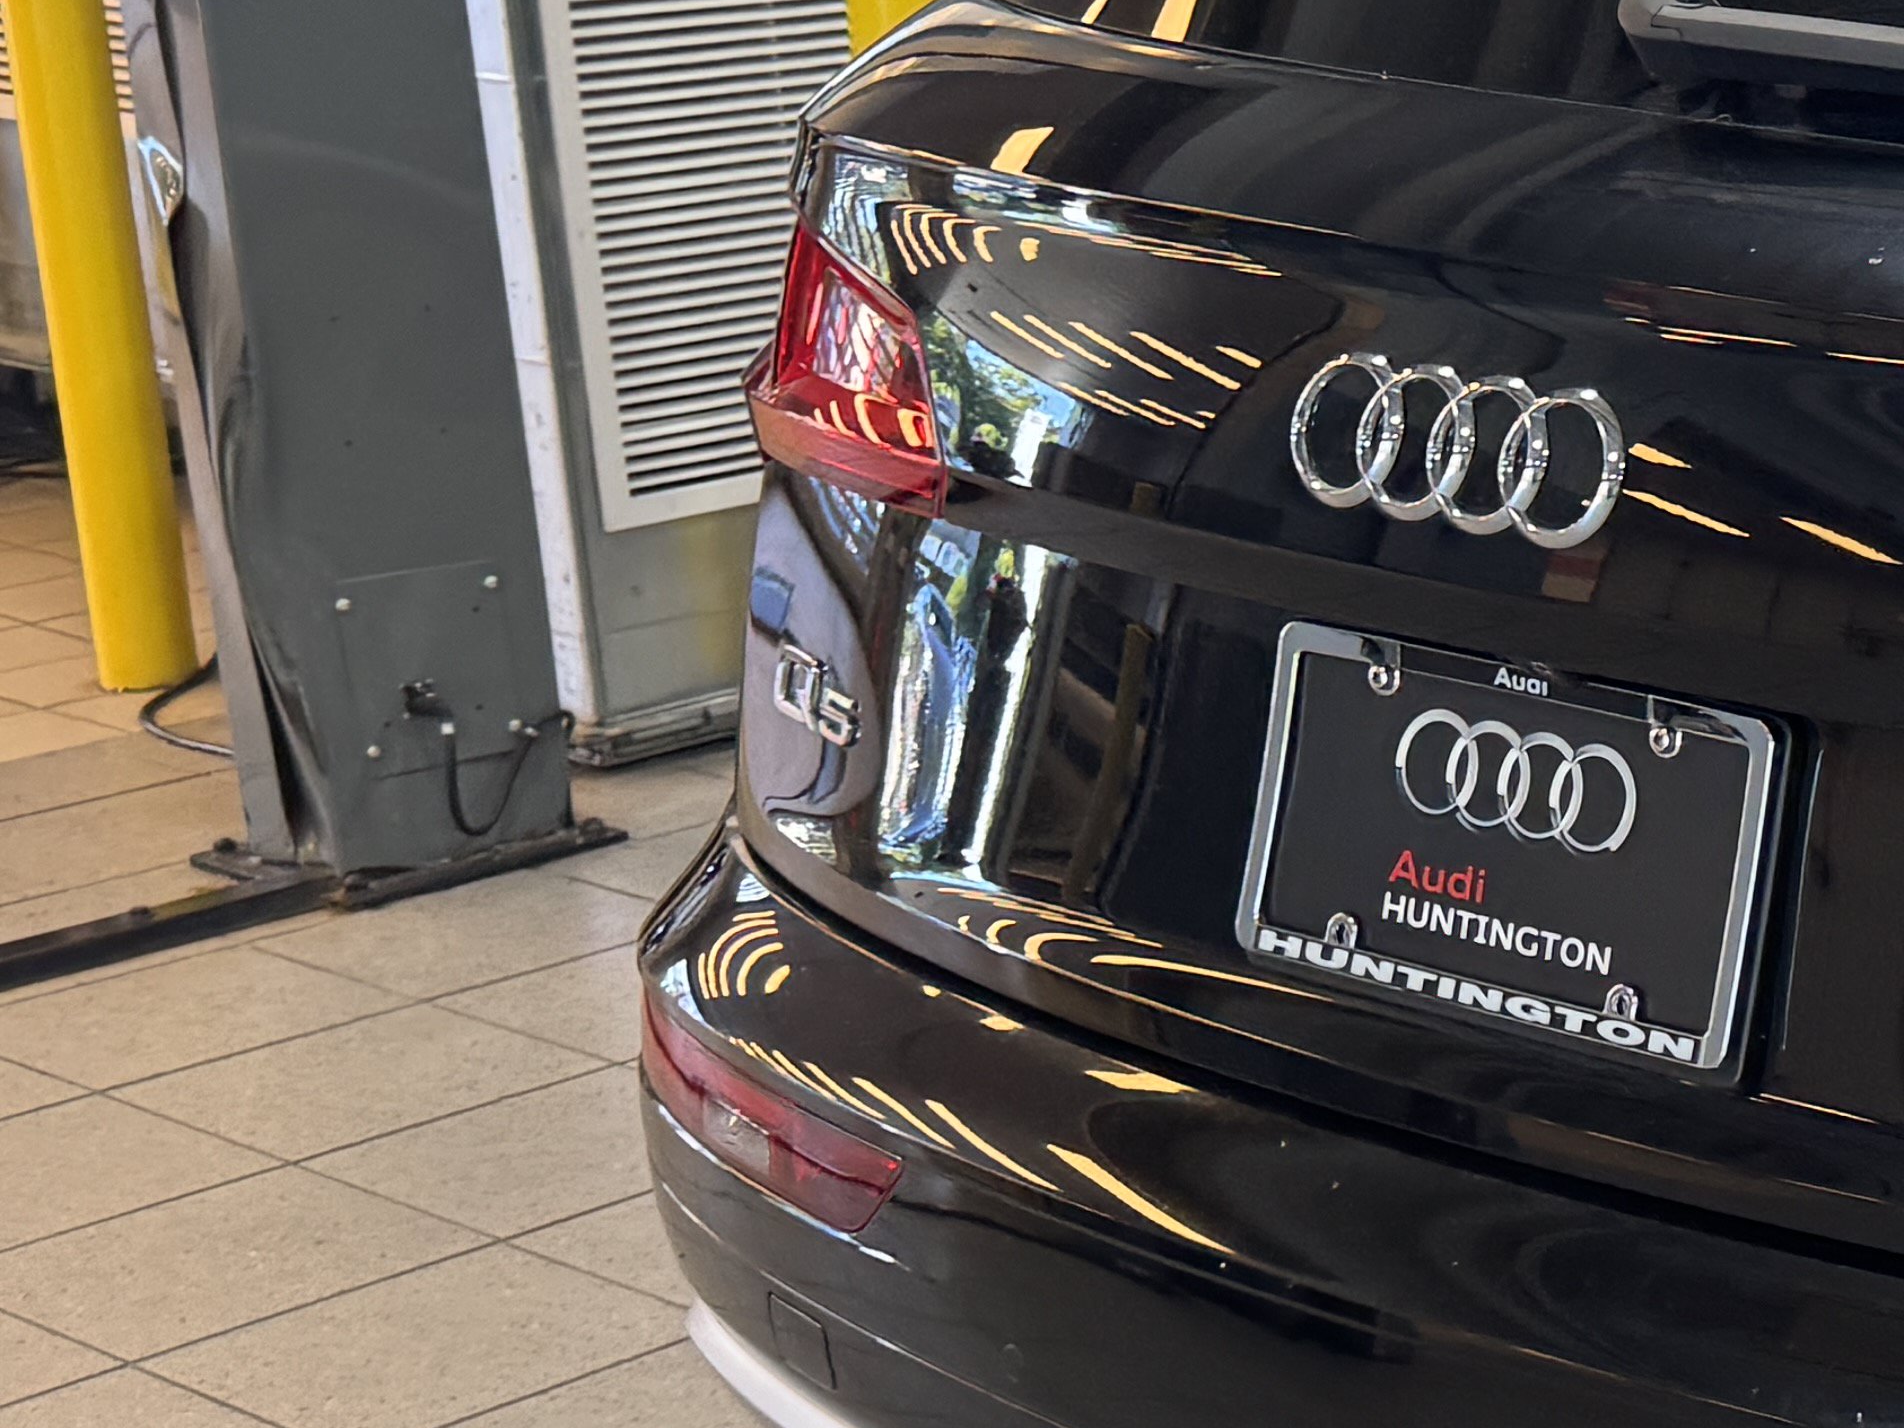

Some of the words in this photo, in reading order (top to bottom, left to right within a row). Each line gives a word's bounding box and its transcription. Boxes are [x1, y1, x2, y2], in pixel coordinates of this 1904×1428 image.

[774, 643, 861, 747] Q5
[1493, 667, 1548, 697] Audi
[1388, 849, 1487, 904] Audi
[1381, 890, 1613, 976] HUNTINGTON
[1257, 929, 1696, 1061] HUNTINGTON
